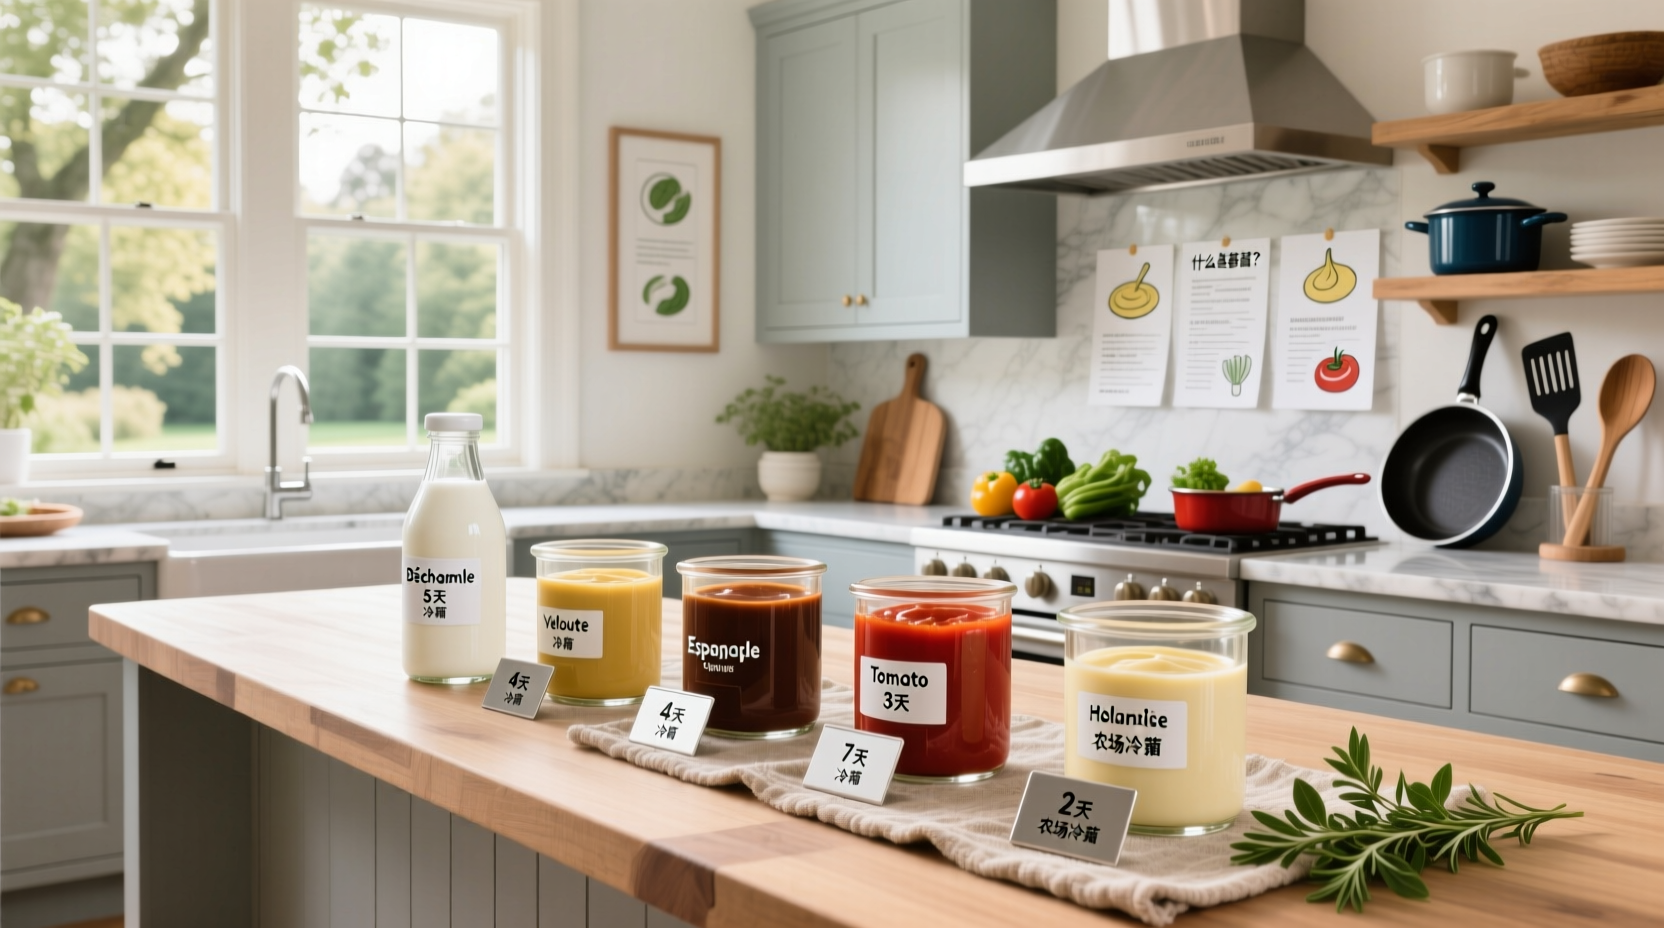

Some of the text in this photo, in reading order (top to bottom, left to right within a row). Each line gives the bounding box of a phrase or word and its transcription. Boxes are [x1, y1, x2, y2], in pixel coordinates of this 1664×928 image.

[423, 588, 446, 604] 5天
[543, 613, 589, 633] Veloute
[508, 671, 531, 691] 4天
[870, 665, 929, 688] Tomato
[659, 701, 686, 724] 4天
[883, 691, 910, 712] 3天
[842, 742, 869, 768] 7天
[1058, 791, 1094, 820] 2天
